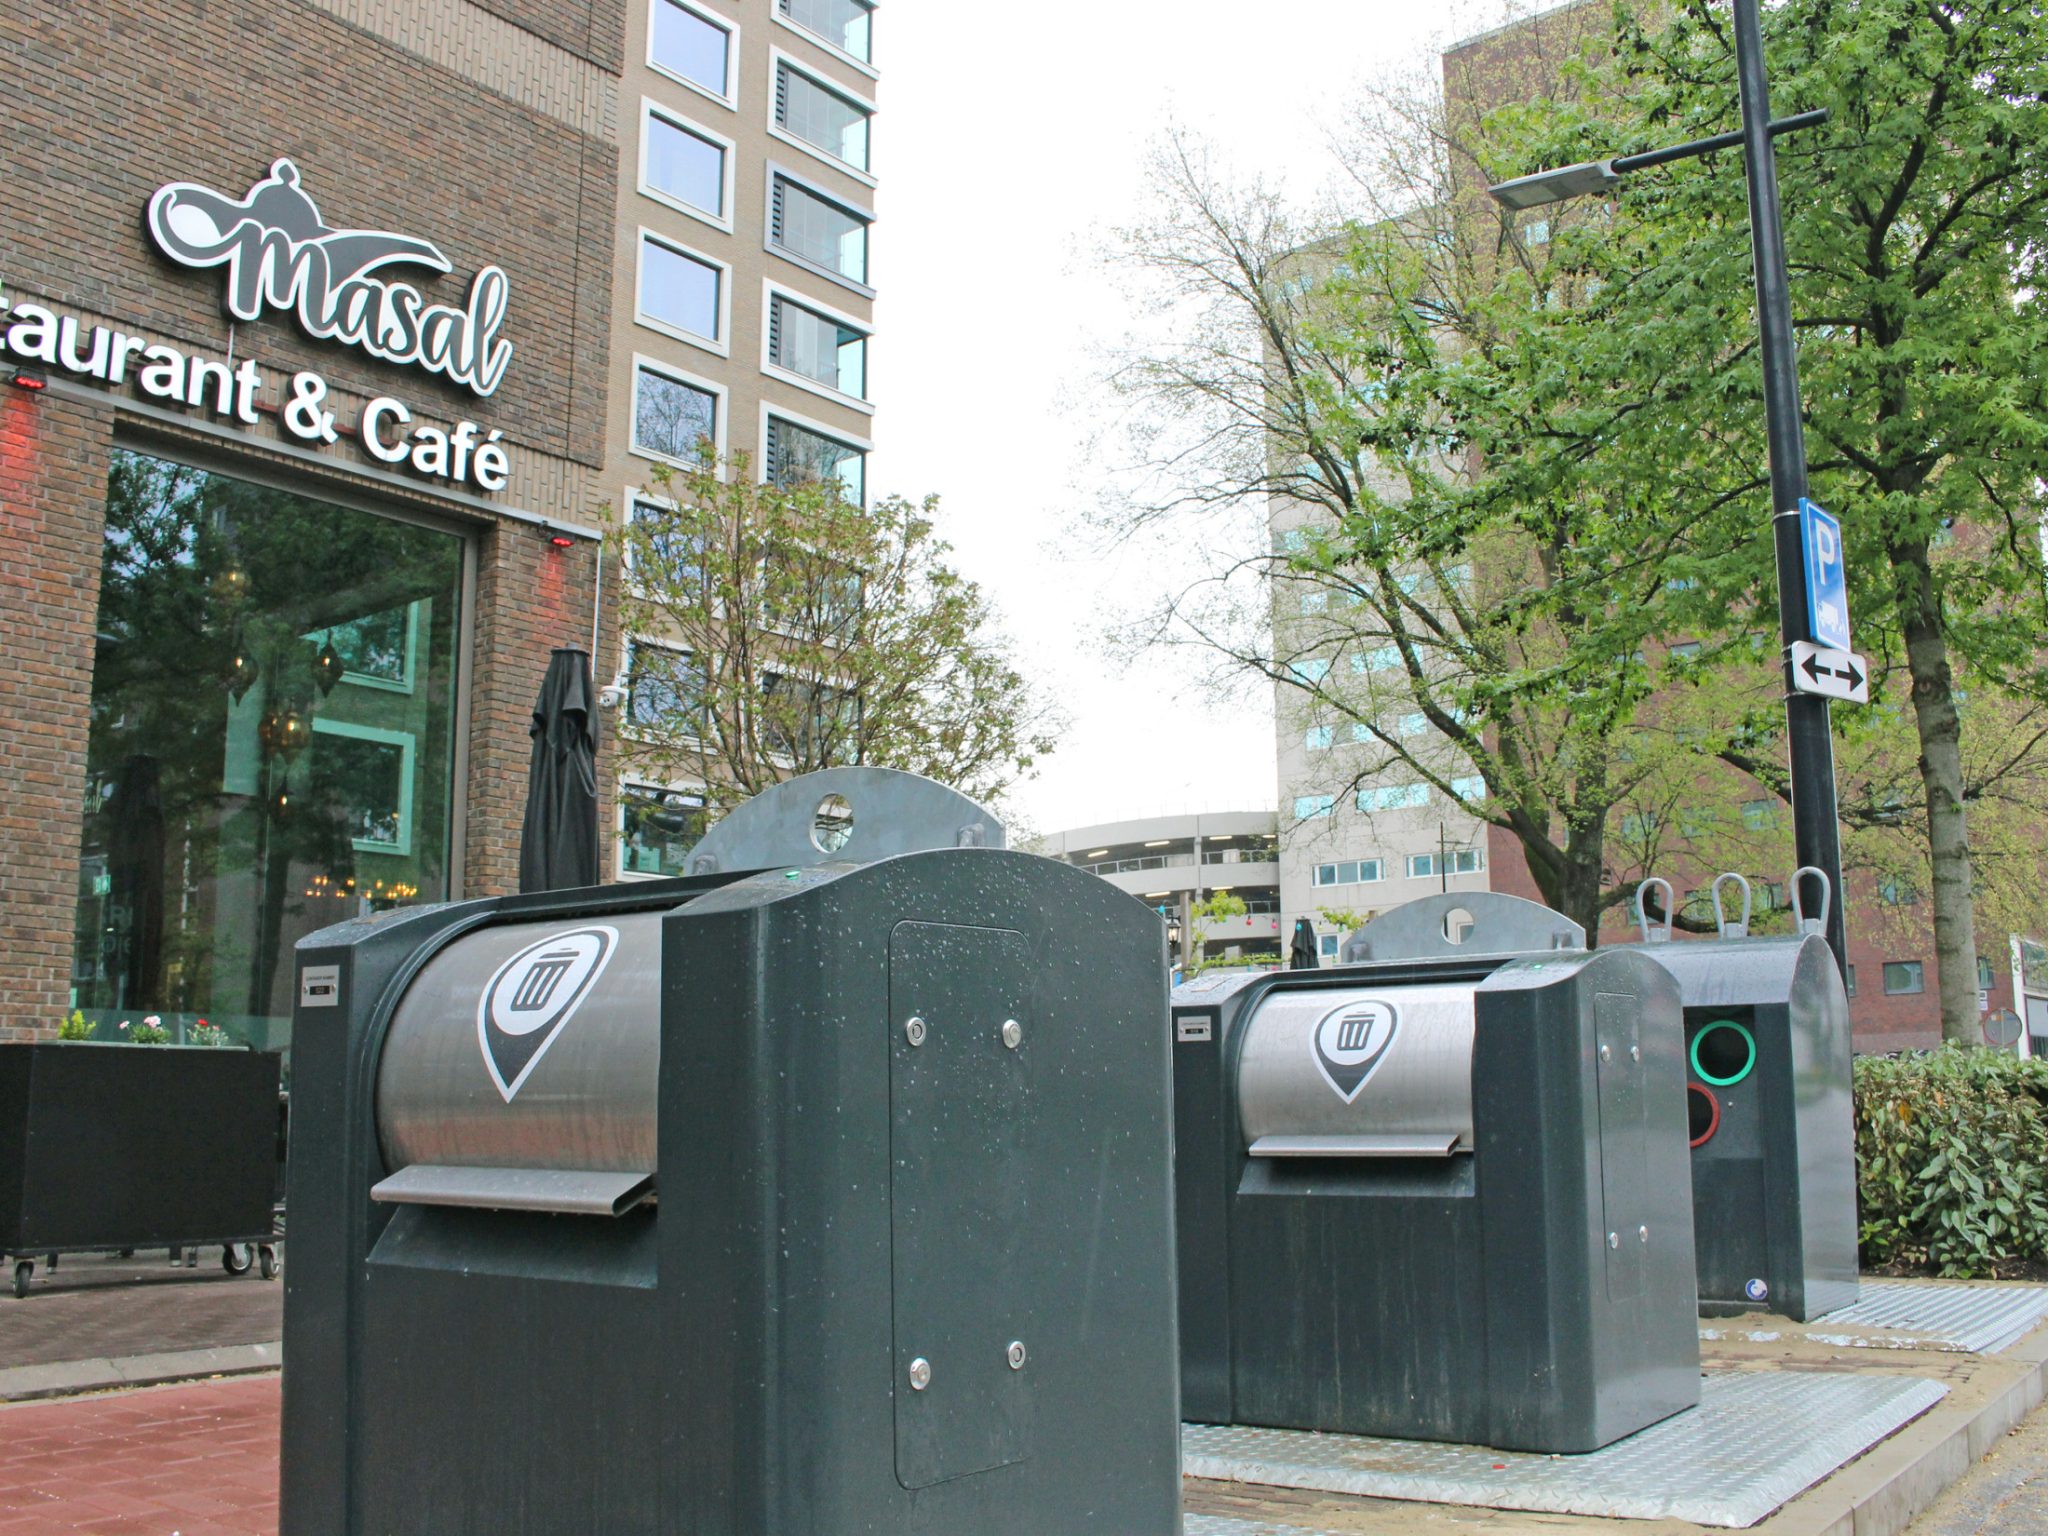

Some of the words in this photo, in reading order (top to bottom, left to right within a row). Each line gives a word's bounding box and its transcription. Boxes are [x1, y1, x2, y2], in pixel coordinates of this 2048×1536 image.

[228, 218, 513, 396] Masal
[283, 371, 338, 444] &
[362, 398, 509, 491] Café
[1815, 519, 1835, 585] P
